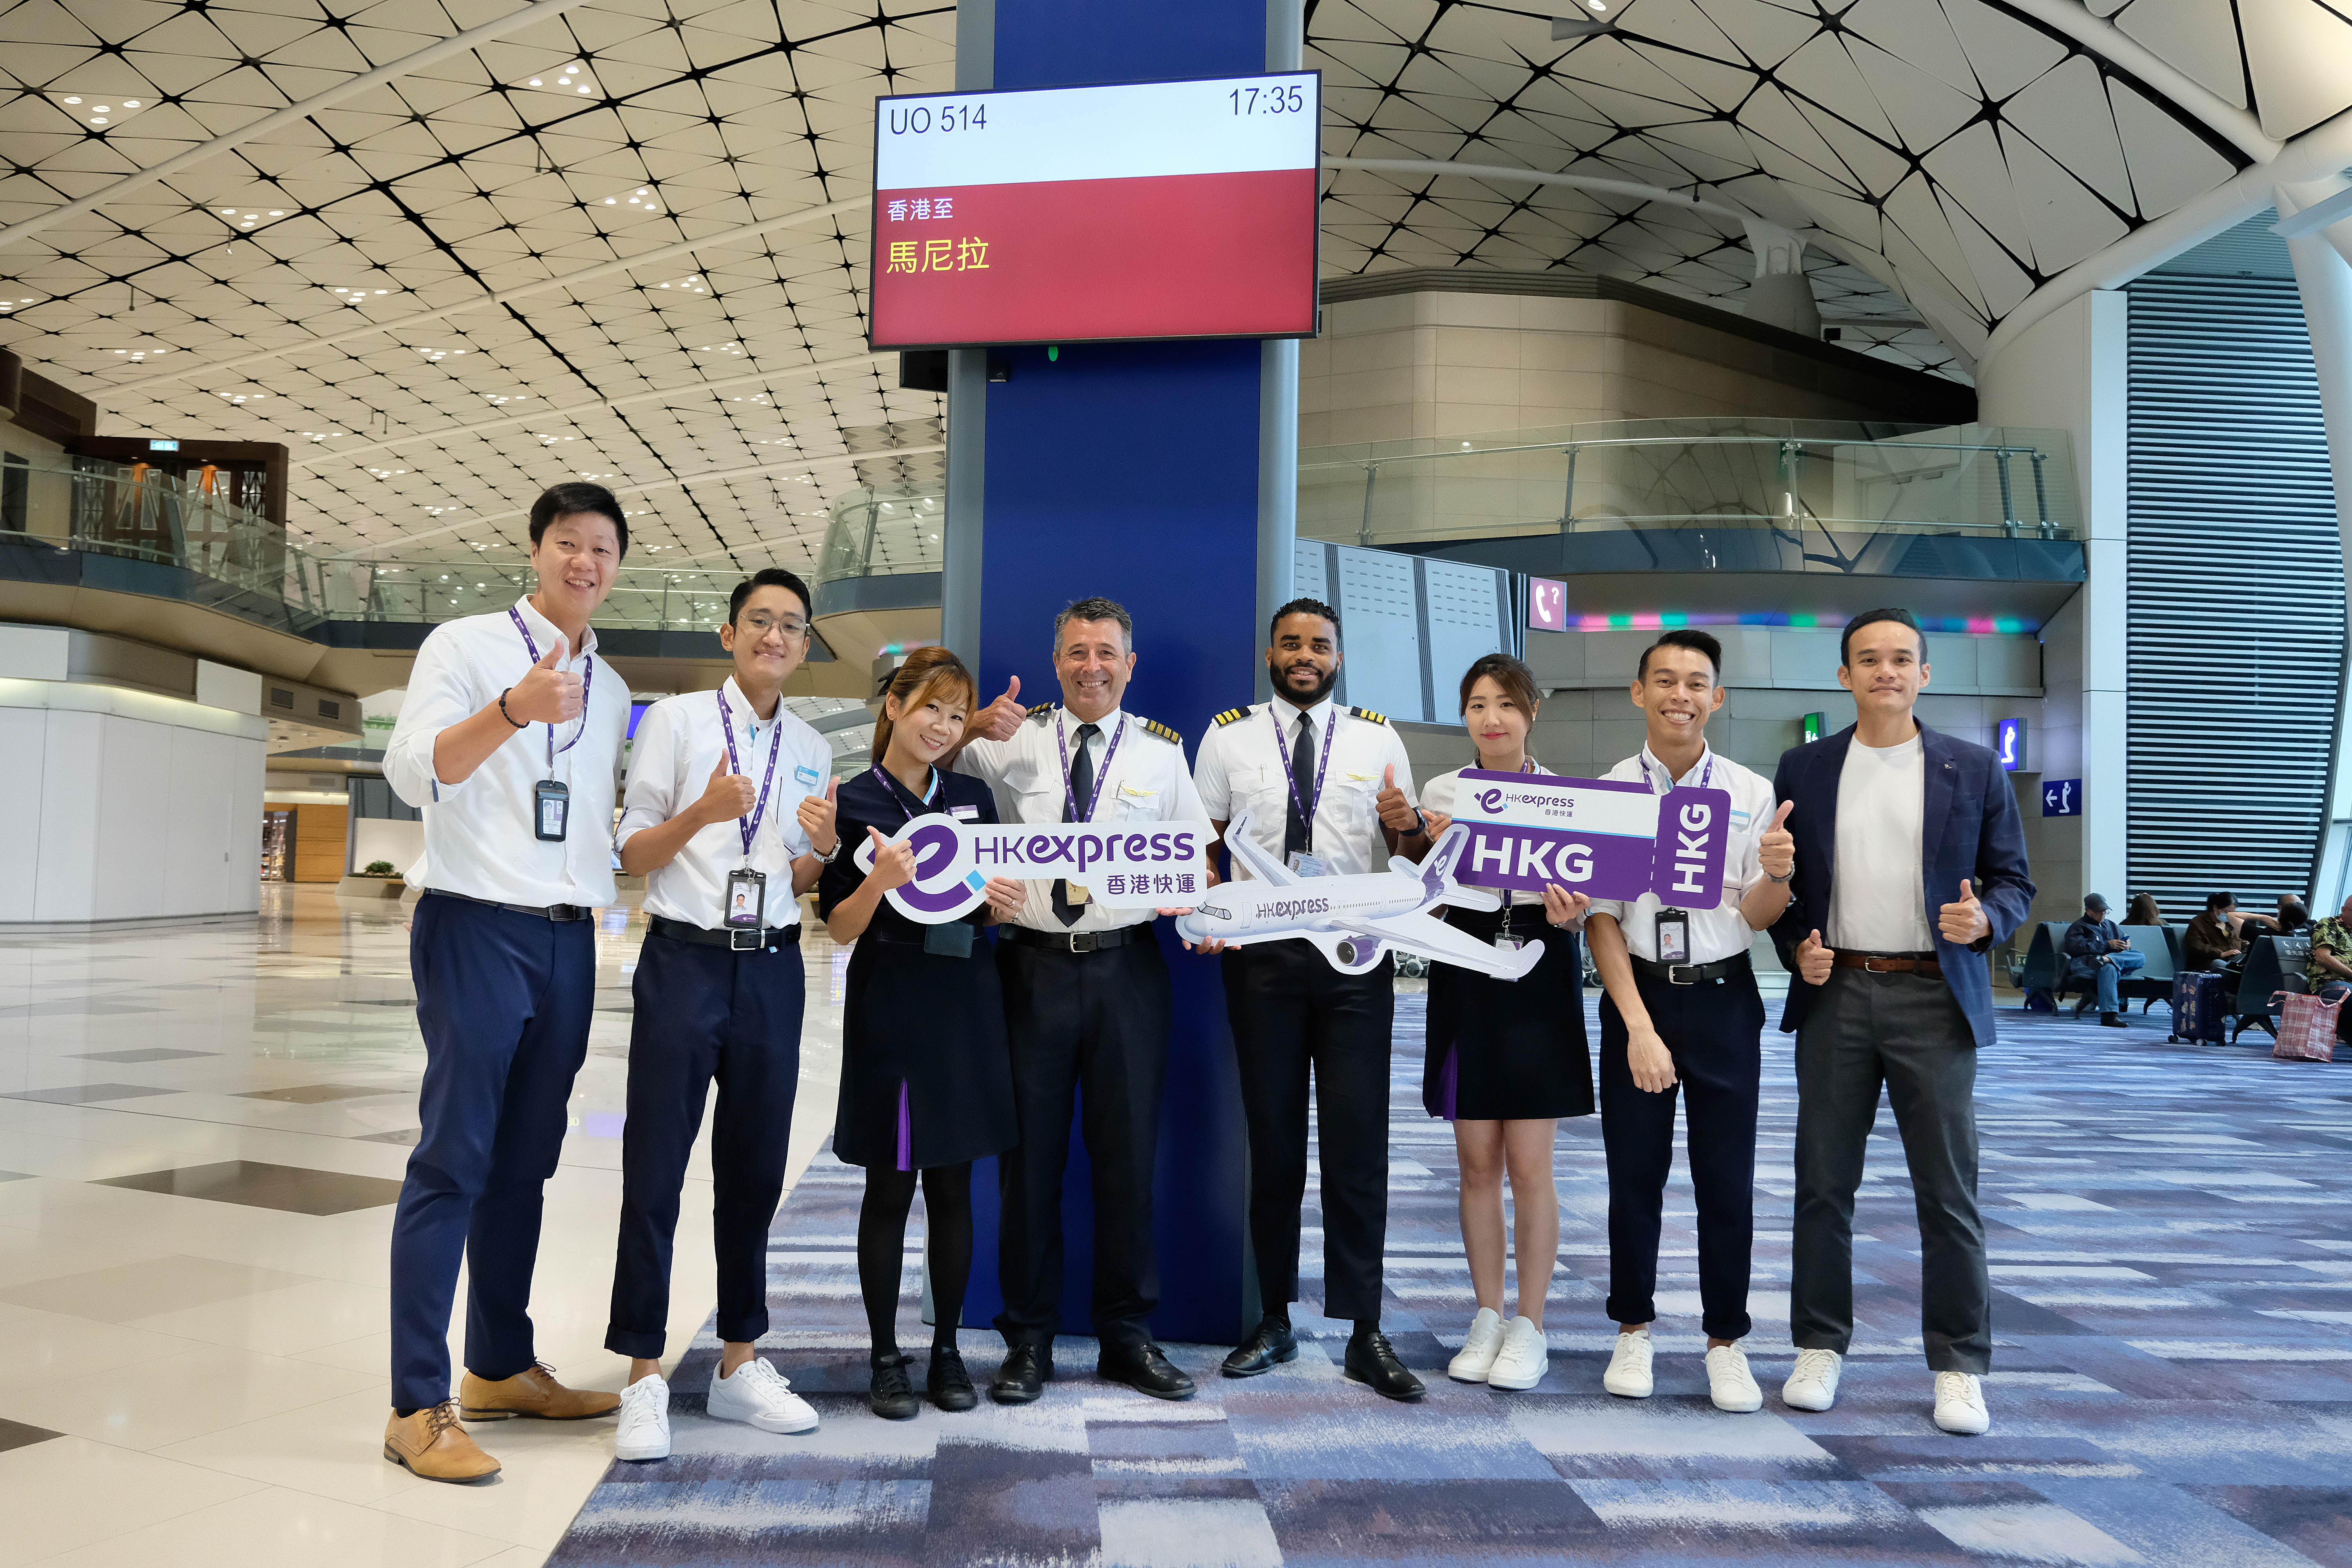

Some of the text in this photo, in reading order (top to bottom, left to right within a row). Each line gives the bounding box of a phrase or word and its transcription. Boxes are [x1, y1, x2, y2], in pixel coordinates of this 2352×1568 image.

[1229, 85, 1303, 116] 17:35
[891, 103, 987, 135] UO 514
[887, 198, 953, 223] 香港至
[886, 236, 990, 274] 馬尼拉
[1506, 793, 1574, 808] HKexpress
[1545, 809, 1573, 817] 香港快運
[975, 833, 1194, 873] HKexpress
[1472, 834, 1594, 882] HKG
[1672, 804, 1711, 893] HKG
[1106, 873, 1196, 895] 香港快運
[1257, 898, 1329, 920] HKexpress
